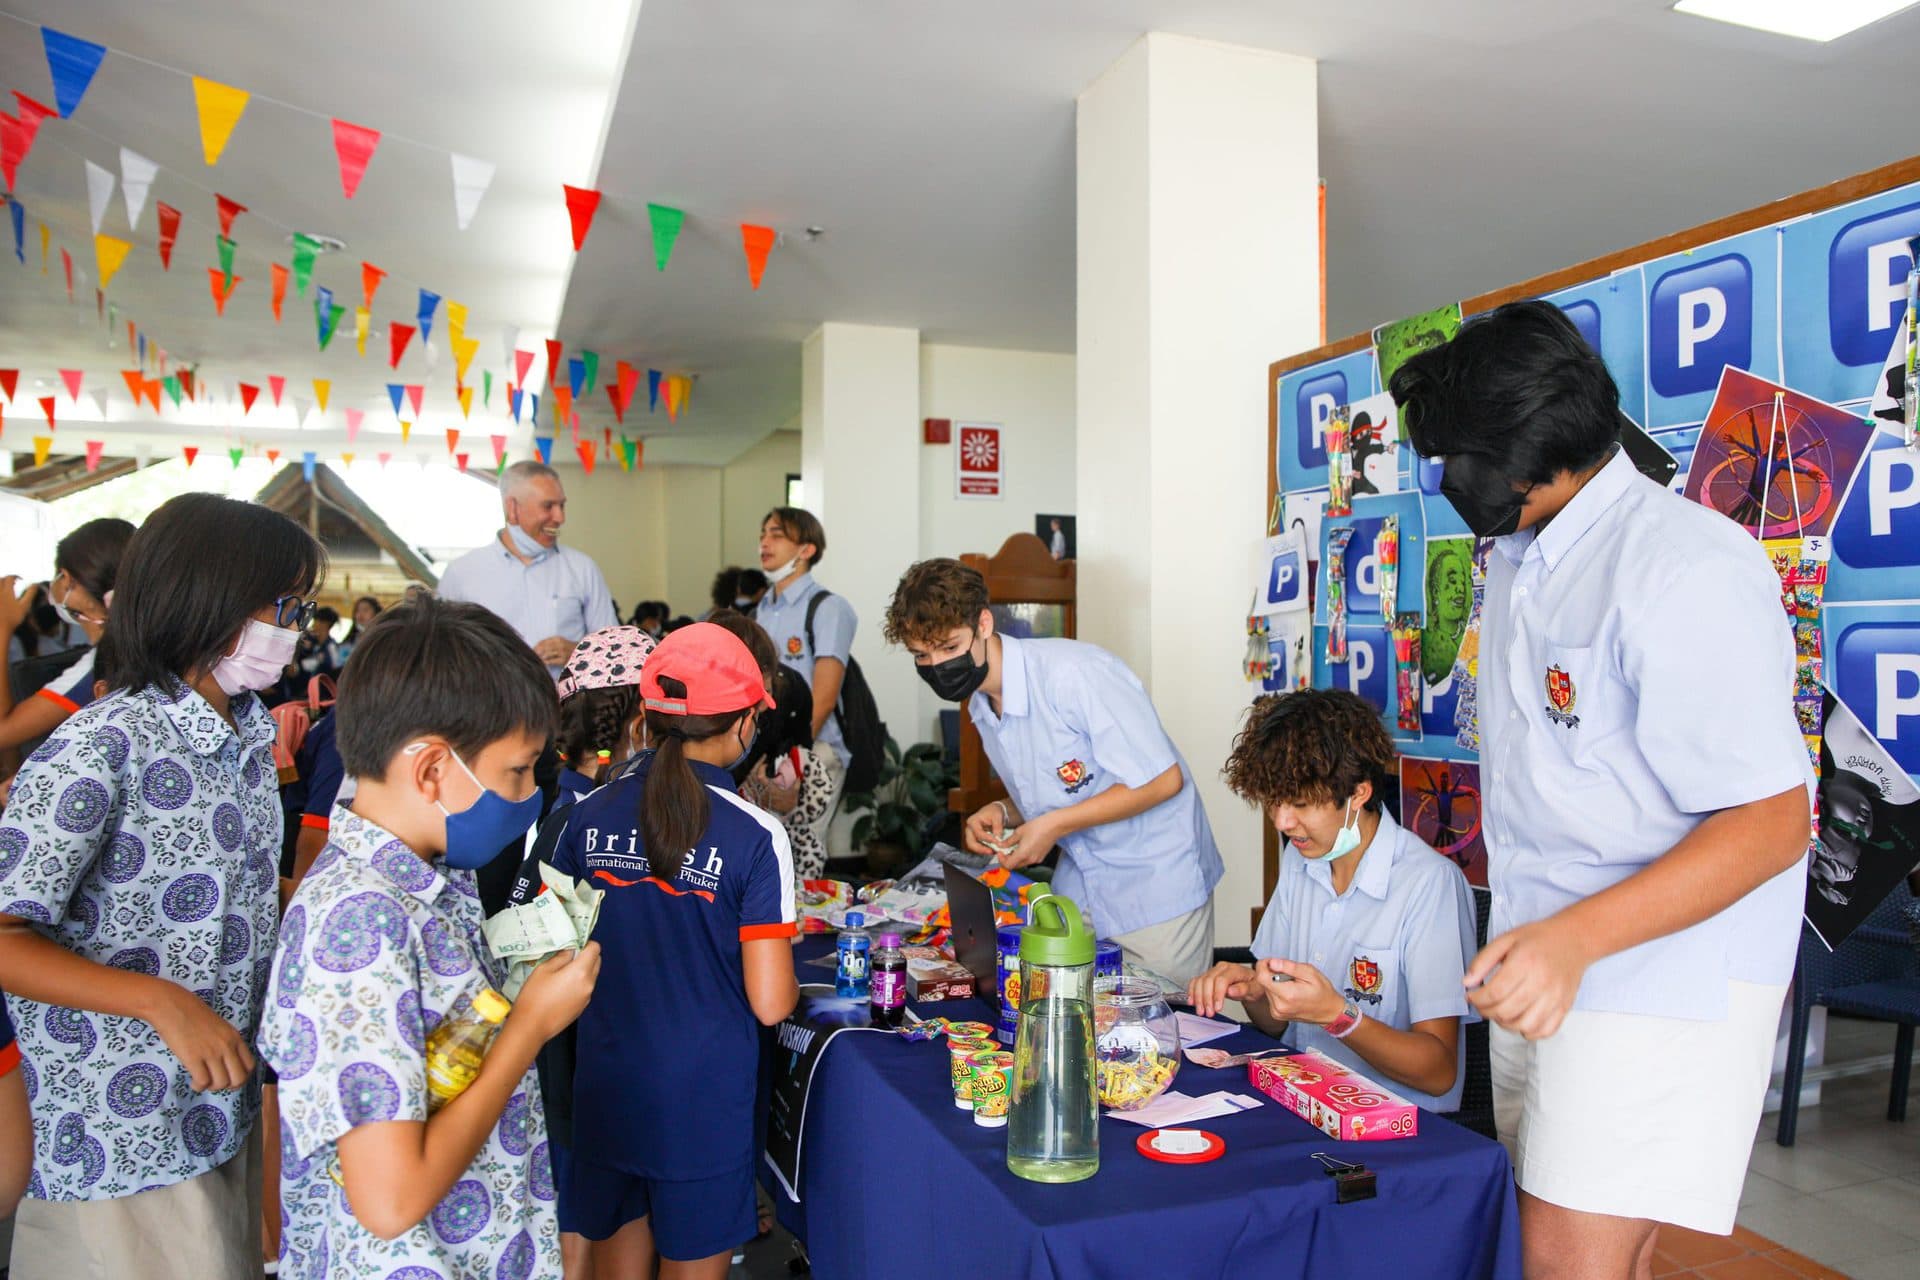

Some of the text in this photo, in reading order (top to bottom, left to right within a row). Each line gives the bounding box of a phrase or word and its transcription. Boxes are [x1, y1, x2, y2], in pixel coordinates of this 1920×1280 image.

[1677, 286, 1728, 369] P
[1310, 392, 1337, 449] P
[1870, 446, 1920, 536] P
[1276, 564, 1293, 593] P
[1347, 640, 1375, 696] P
[1875, 652, 1920, 741] P
[585, 828, 724, 876] Brish
[679, 869, 719, 891] Phuket
